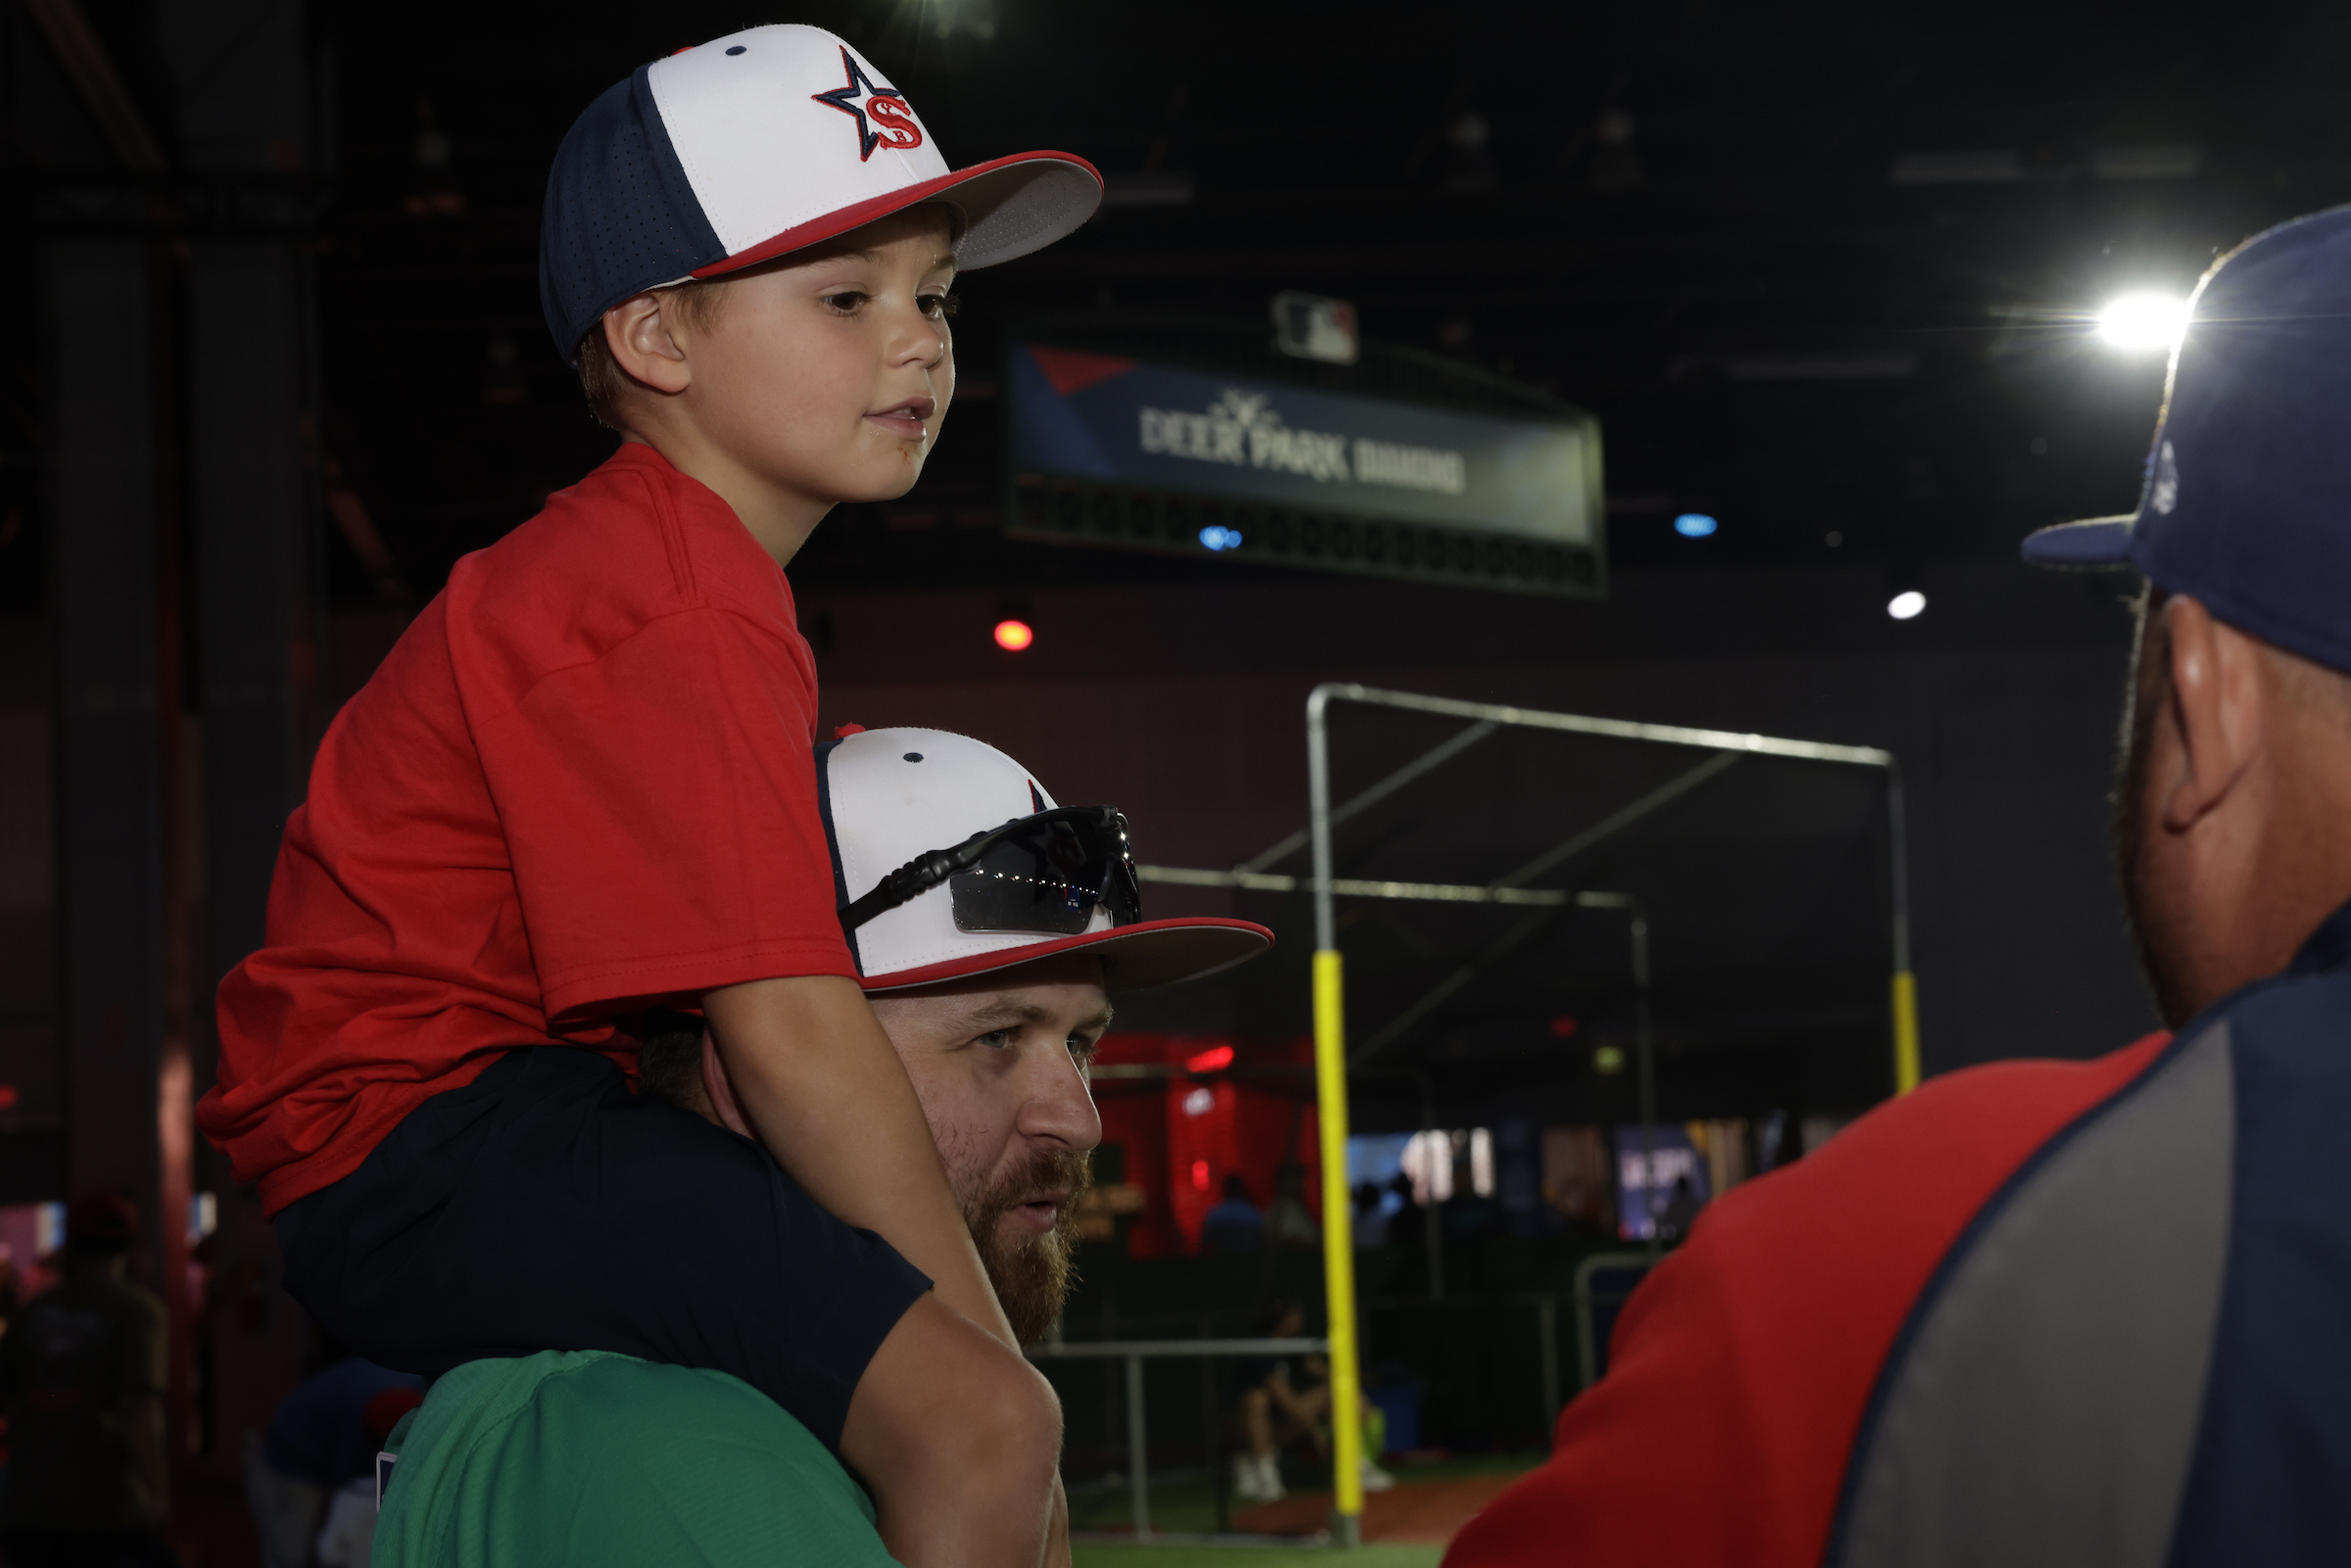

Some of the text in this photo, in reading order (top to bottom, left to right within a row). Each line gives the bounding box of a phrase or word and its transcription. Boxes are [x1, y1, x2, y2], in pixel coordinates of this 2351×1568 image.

[866, 95, 922, 150] S
[1140, 407, 1246, 467] DEER
[1249, 425, 1351, 482] PARK
